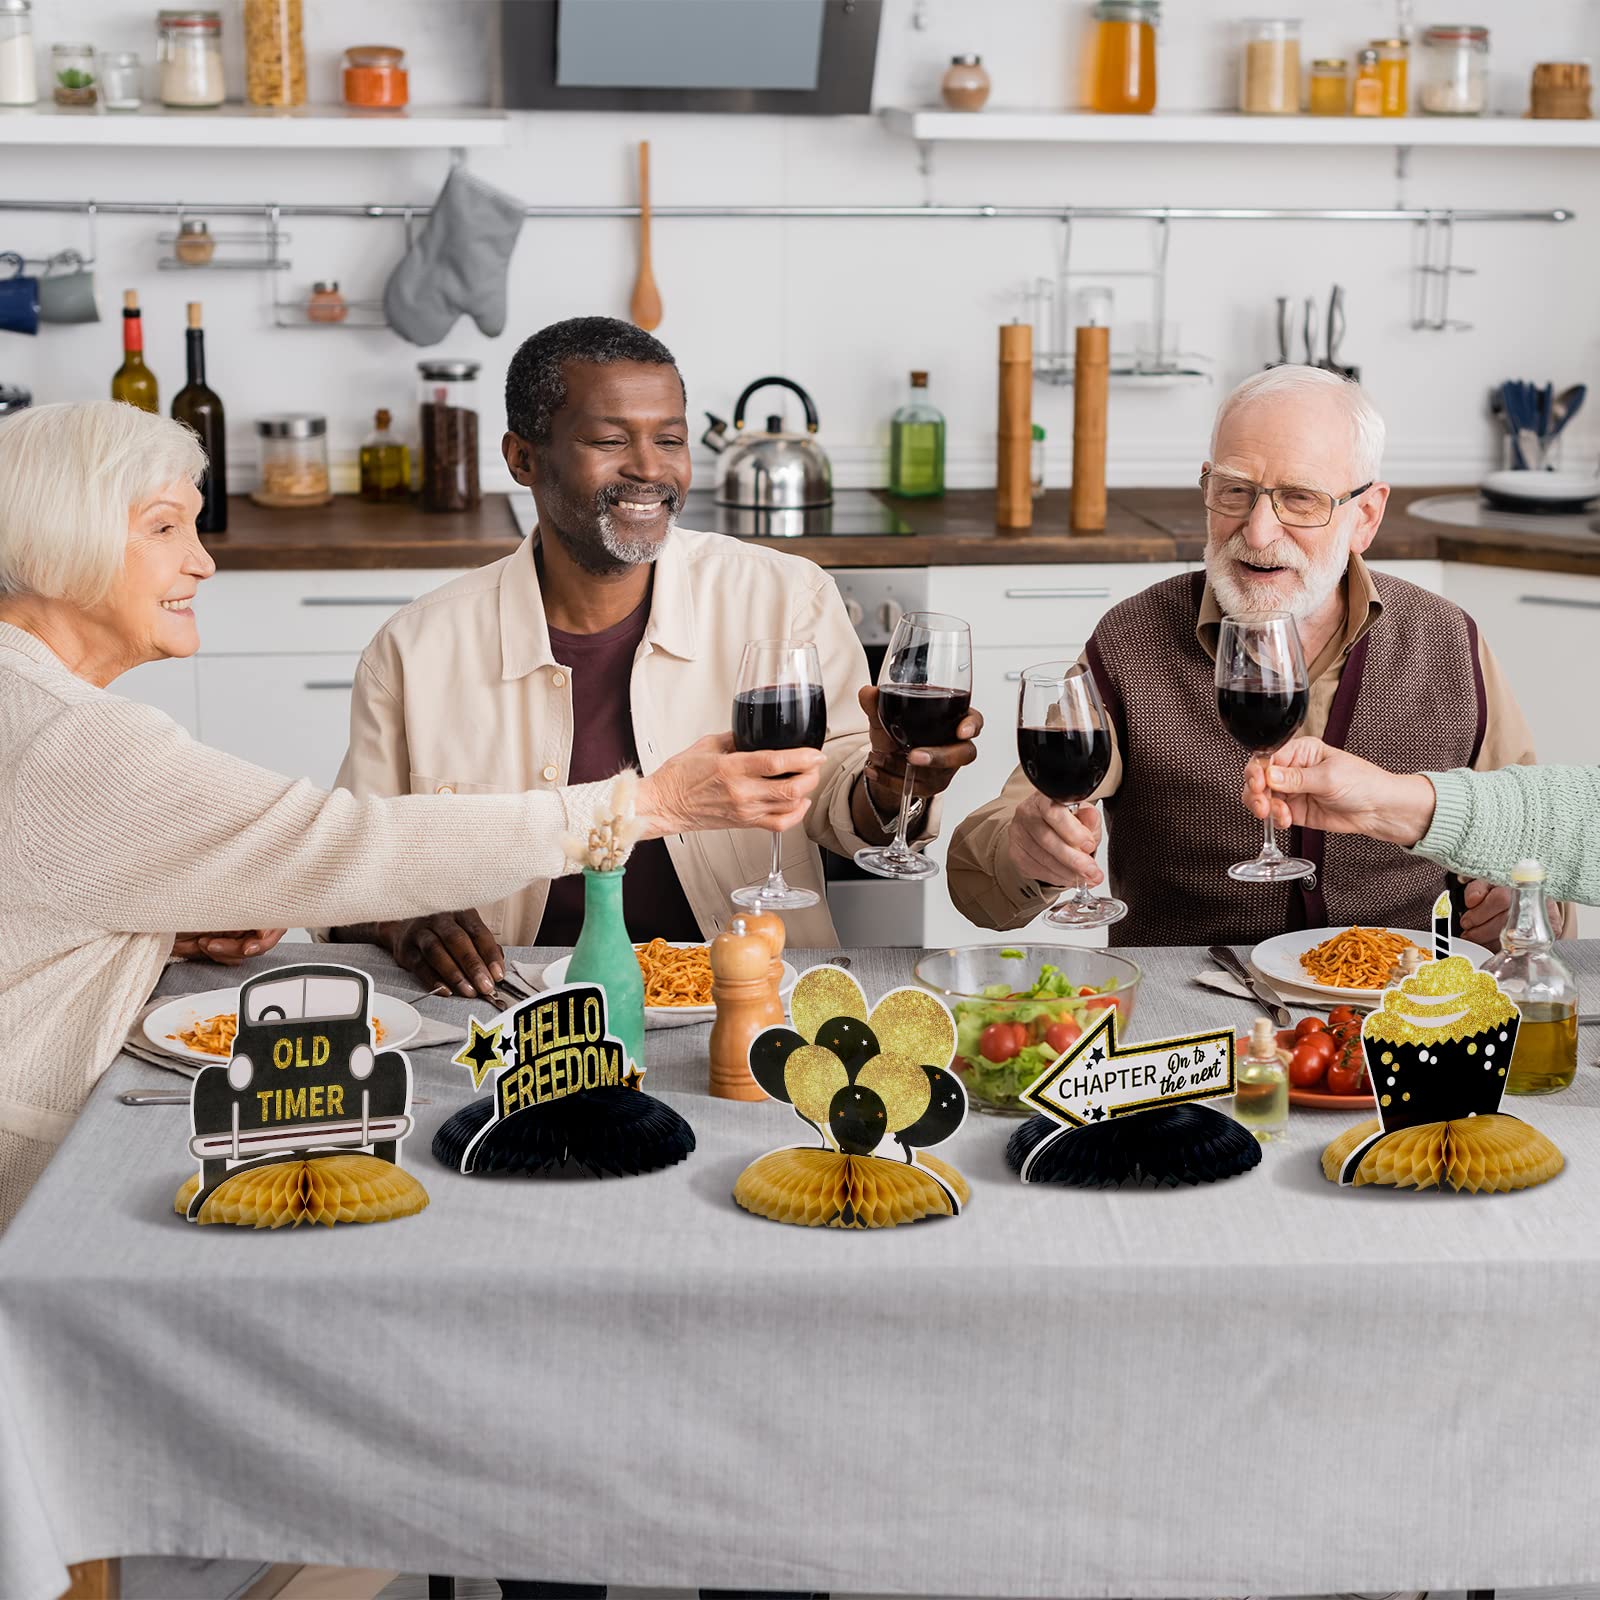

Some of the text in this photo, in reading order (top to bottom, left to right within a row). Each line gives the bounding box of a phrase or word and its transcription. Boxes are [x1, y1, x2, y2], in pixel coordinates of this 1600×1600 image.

[518, 996, 600, 1064] HELLO
[272, 1035, 331, 1070] OLD
[1167, 1046, 1205, 1075] On to
[502, 1046, 619, 1117] FREEDOM
[1058, 1065, 1157, 1099] CHAPTER
[1159, 1058, 1222, 1096] the next
[256, 1084, 345, 1122] TIMER
